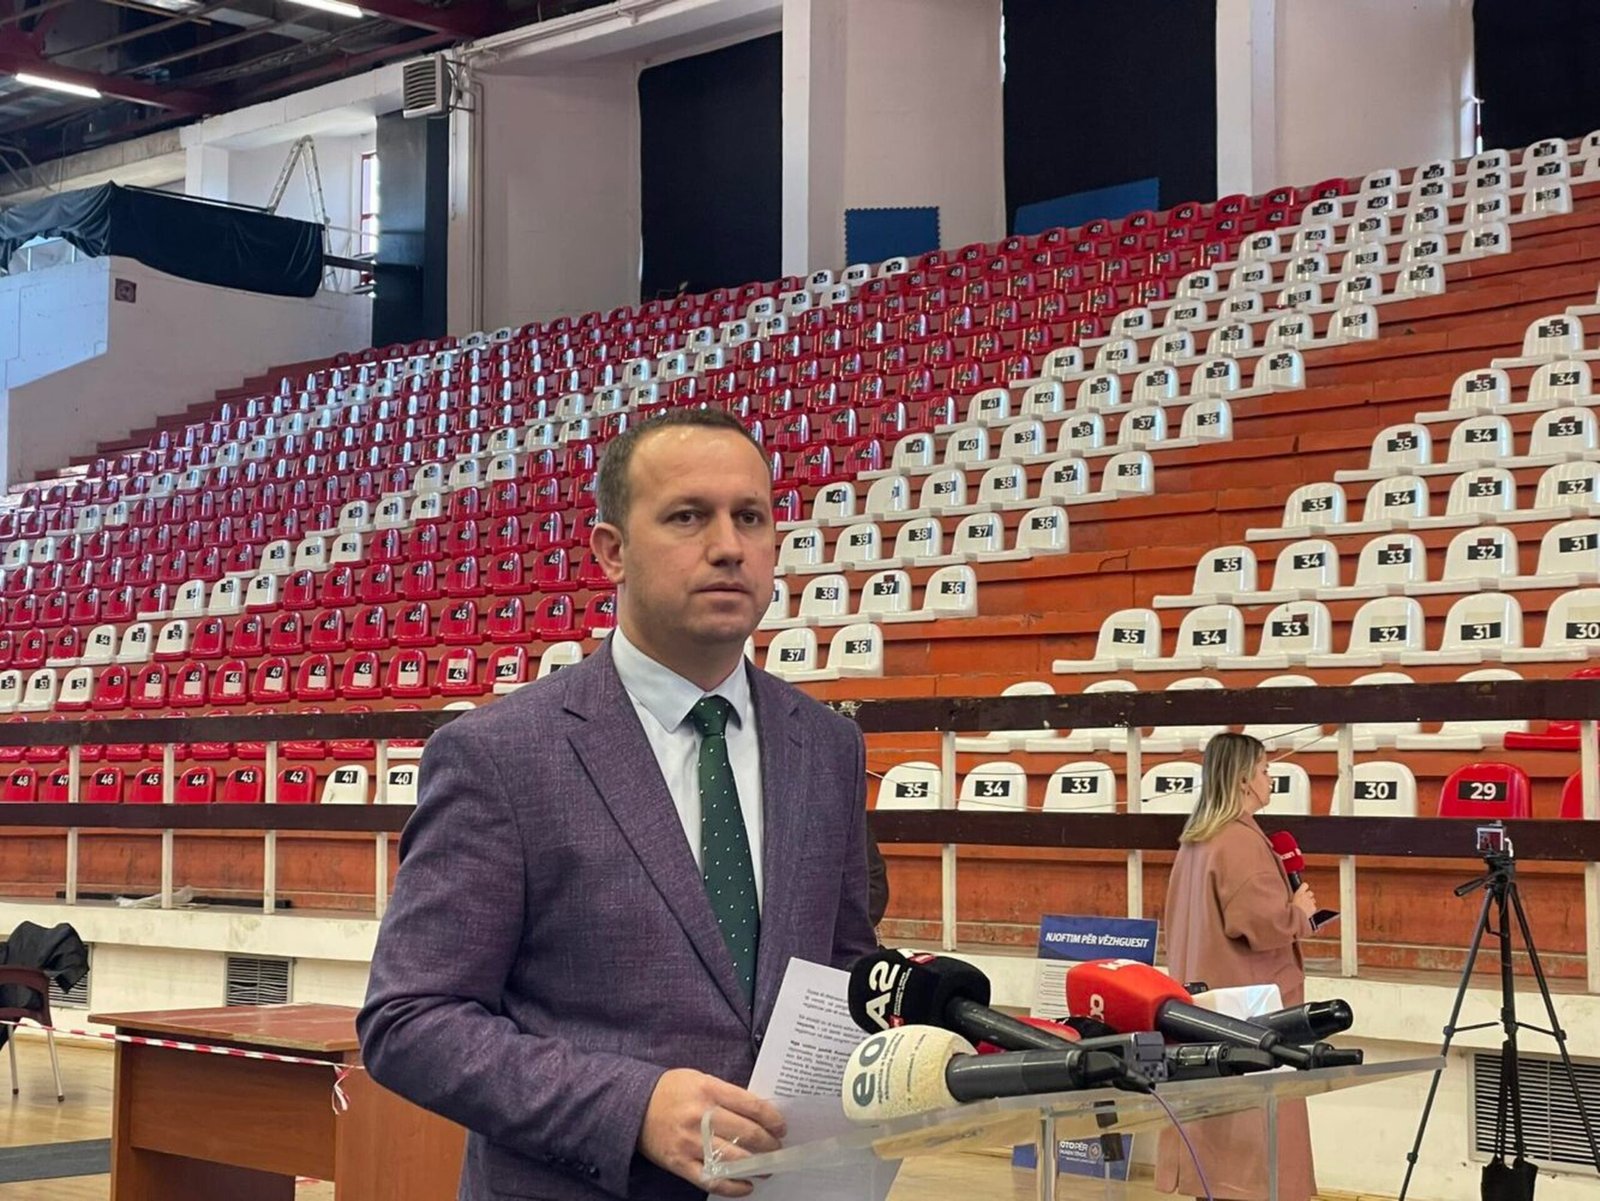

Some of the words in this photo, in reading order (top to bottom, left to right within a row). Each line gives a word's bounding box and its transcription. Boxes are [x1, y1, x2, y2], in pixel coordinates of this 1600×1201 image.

[1226, 205, 1238, 213] 44
[1227, 329, 1239, 339] 38
[1285, 325, 1298, 334] 37
[1547, 326, 1562, 336] 35
[1171, 342, 1182, 351] 39
[1113, 350, 1125, 360] 40
[1061, 357, 1071, 367] 41
[1277, 358, 1289, 368] 36
[1213, 367, 1225, 377] 37
[1153, 375, 1165, 385] 38
[1557, 374, 1574, 384] 34
[1096, 383, 1108, 392] 39
[1474, 381, 1489, 391] 35
[1040, 393, 1052, 401] 40
[988, 400, 997, 408] 41
[1139, 418, 1152, 428] 37
[1204, 414, 1216, 424] 36
[1079, 426, 1091, 436] 38
[1558, 423, 1575, 435] 33
[1021, 432, 1032, 441] 39
[1473, 431, 1491, 441] 34
[912, 442, 921, 451] 41
[1396, 437, 1411, 450] 35
[811, 455, 821, 463] 43
[1125, 465, 1138, 475] 36
[1061, 470, 1074, 481] 37
[941, 484, 952, 493] 39
[1001, 479, 1012, 488] 38
[1568, 482, 1585, 492] 32
[1478, 484, 1495, 495] 33
[833, 492, 841, 501] 41
[1393, 491, 1410, 504] 34
[1310, 499, 1327, 510] 35
[1039, 519, 1051, 528] 36
[916, 530, 927, 539] 38
[975, 527, 987, 536] 37
[799, 539, 812, 547] 40
[856, 535, 868, 544] 39
[1571, 537, 1587, 549] 31
[1388, 550, 1405, 562] 33
[1477, 547, 1495, 559] 32
[549, 555, 559, 564] 45
[1302, 555, 1319, 567] 34
[502, 561, 513, 569] 46
[1222, 560, 1239, 571] 35
[881, 584, 893, 594] 37
[948, 583, 961, 592] 36
[822, 589, 835, 599] 38
[553, 606, 564, 615] 43
[601, 603, 613, 611] 42
[410, 611, 420, 620] 46
[456, 610, 466, 619] 45
[500, 609, 512, 618] 44
[247, 624, 256, 632] 50
[285, 623, 294, 632] 49
[325, 620, 335, 629] 48
[1282, 623, 1300, 635] 33
[1122, 630, 1138, 642] 35
[1379, 628, 1398, 641] 32
[1473, 626, 1490, 638] 31
[1576, 624, 1599, 638] 30
[100, 636, 109, 644] 54
[1201, 632, 1220, 643] 34
[853, 642, 866, 652] 36
[787, 650, 800, 660] 37
[314, 666, 324, 674] 46
[359, 664, 370, 673] 45
[405, 662, 417, 671] 44
[501, 665, 513, 674] 42
[190, 672, 199, 681] 49
[271, 667, 281, 677] 47
[454, 669, 464, 679] 43
[151, 674, 160, 684] 50
[231, 673, 240, 682] 48
[39, 680, 48, 688] 53
[76, 679, 84, 688] 52
[18, 777, 28, 786] 48
[57, 775, 68, 785] 47
[101, 775, 113, 784] 46
[147, 775, 158, 784] 45
[193, 776, 205, 785] 44
[241, 772, 253, 781] 43
[290, 773, 303, 782] 42
[342, 773, 352, 782] 41
[395, 774, 409, 784] 40
[984, 782, 1004, 795] 34
[1072, 779, 1090, 792] 33
[1166, 778, 1185, 792] 32
[905, 784, 922, 797] 35
[1365, 783, 1389, 799] 30
[1471, 783, 1497, 799] 29
[1045, 932, 1081, 943] NJOFTIM
[1081, 933, 1097, 945] PËR
[1098, 934, 1149, 948] VËZHGUESIT
[866, 961, 901, 1029] A2
[1059, 1141, 1074, 1150] OTO
